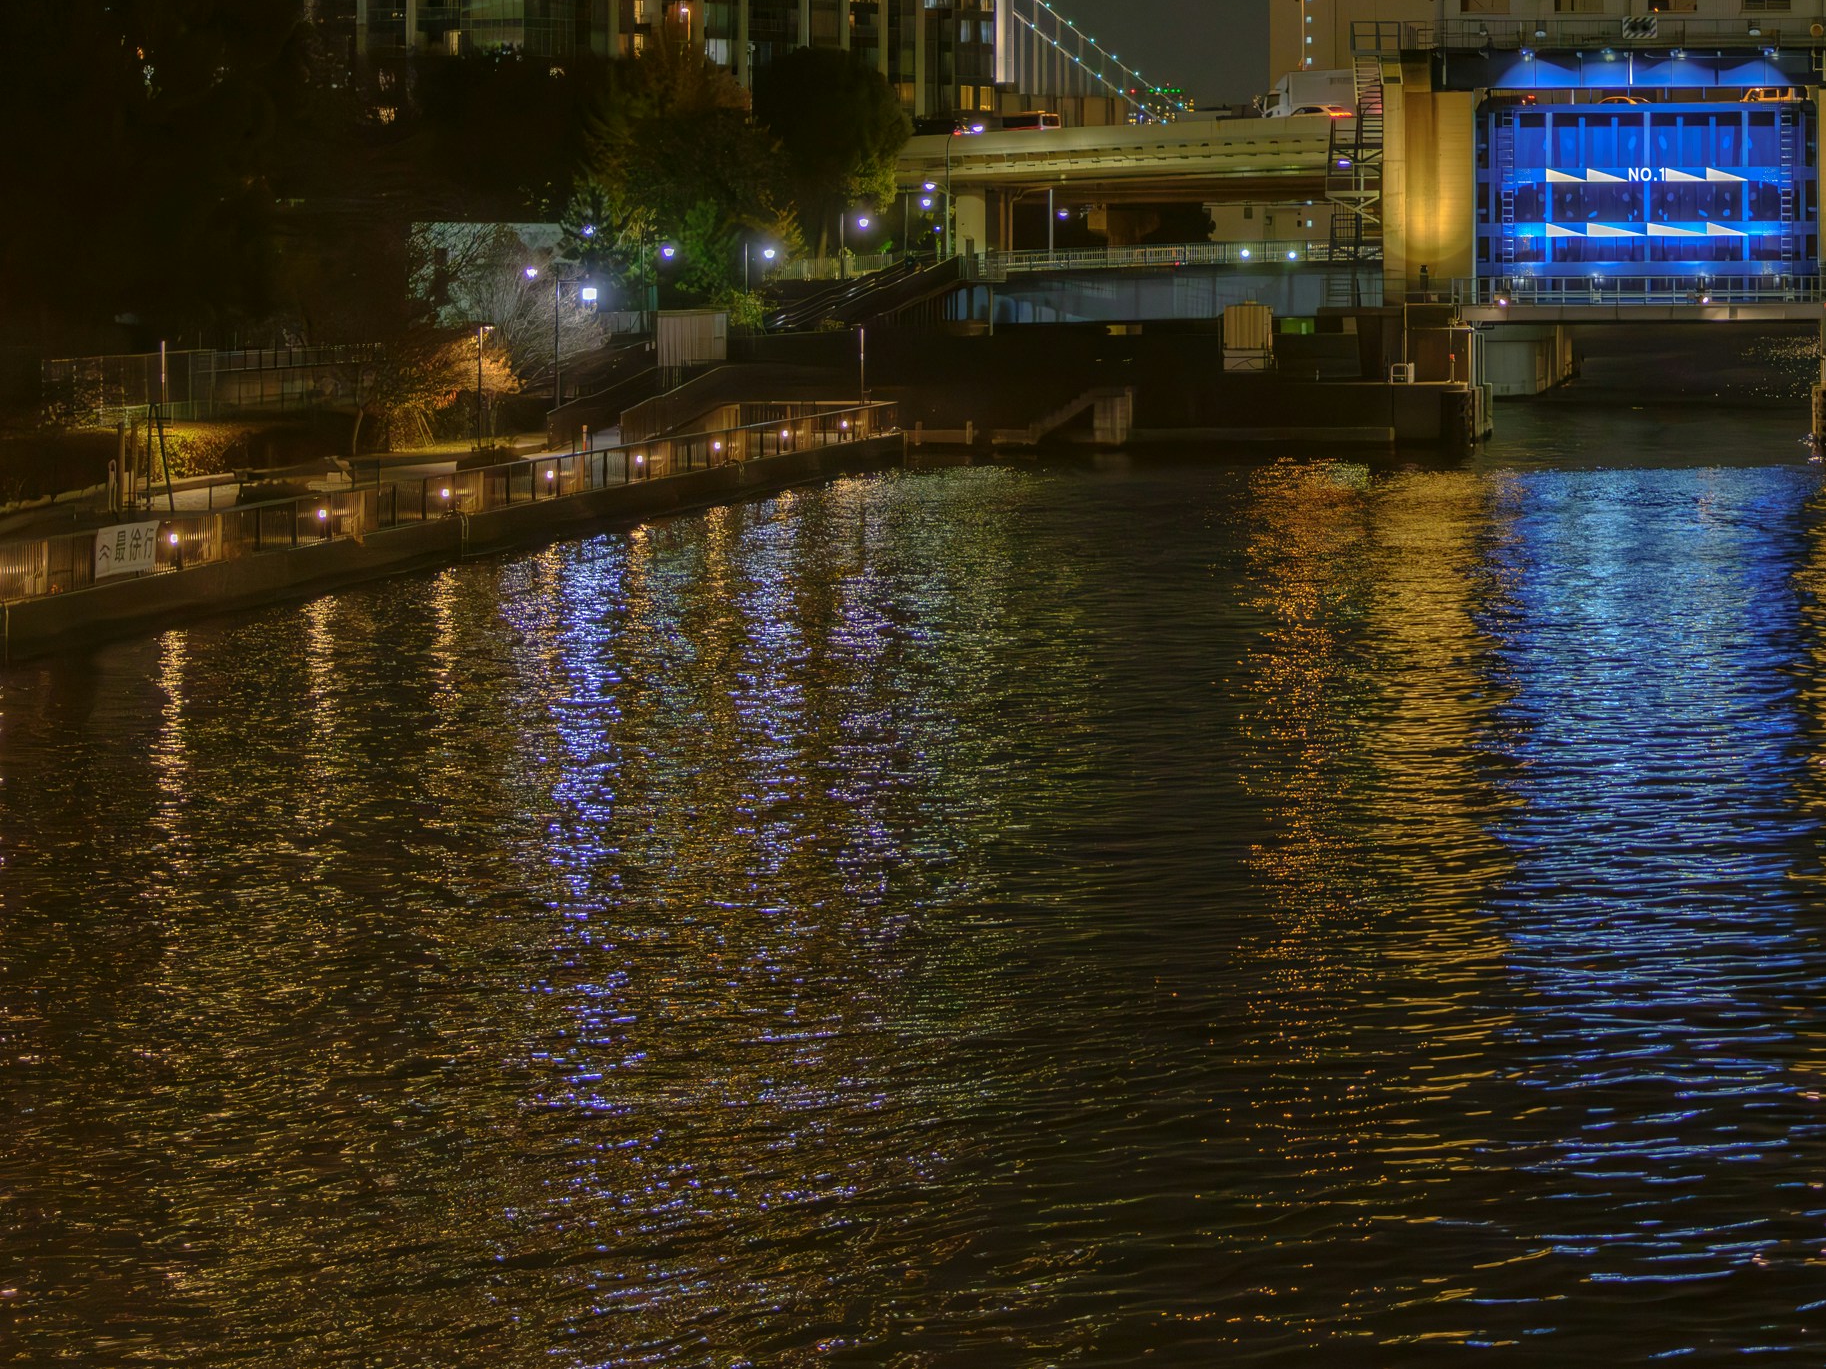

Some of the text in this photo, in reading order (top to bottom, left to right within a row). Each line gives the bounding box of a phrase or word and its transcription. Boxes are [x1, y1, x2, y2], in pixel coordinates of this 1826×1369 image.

[1628, 167, 1665, 182] NO.1
[114, 527, 155, 563] 最徐行
